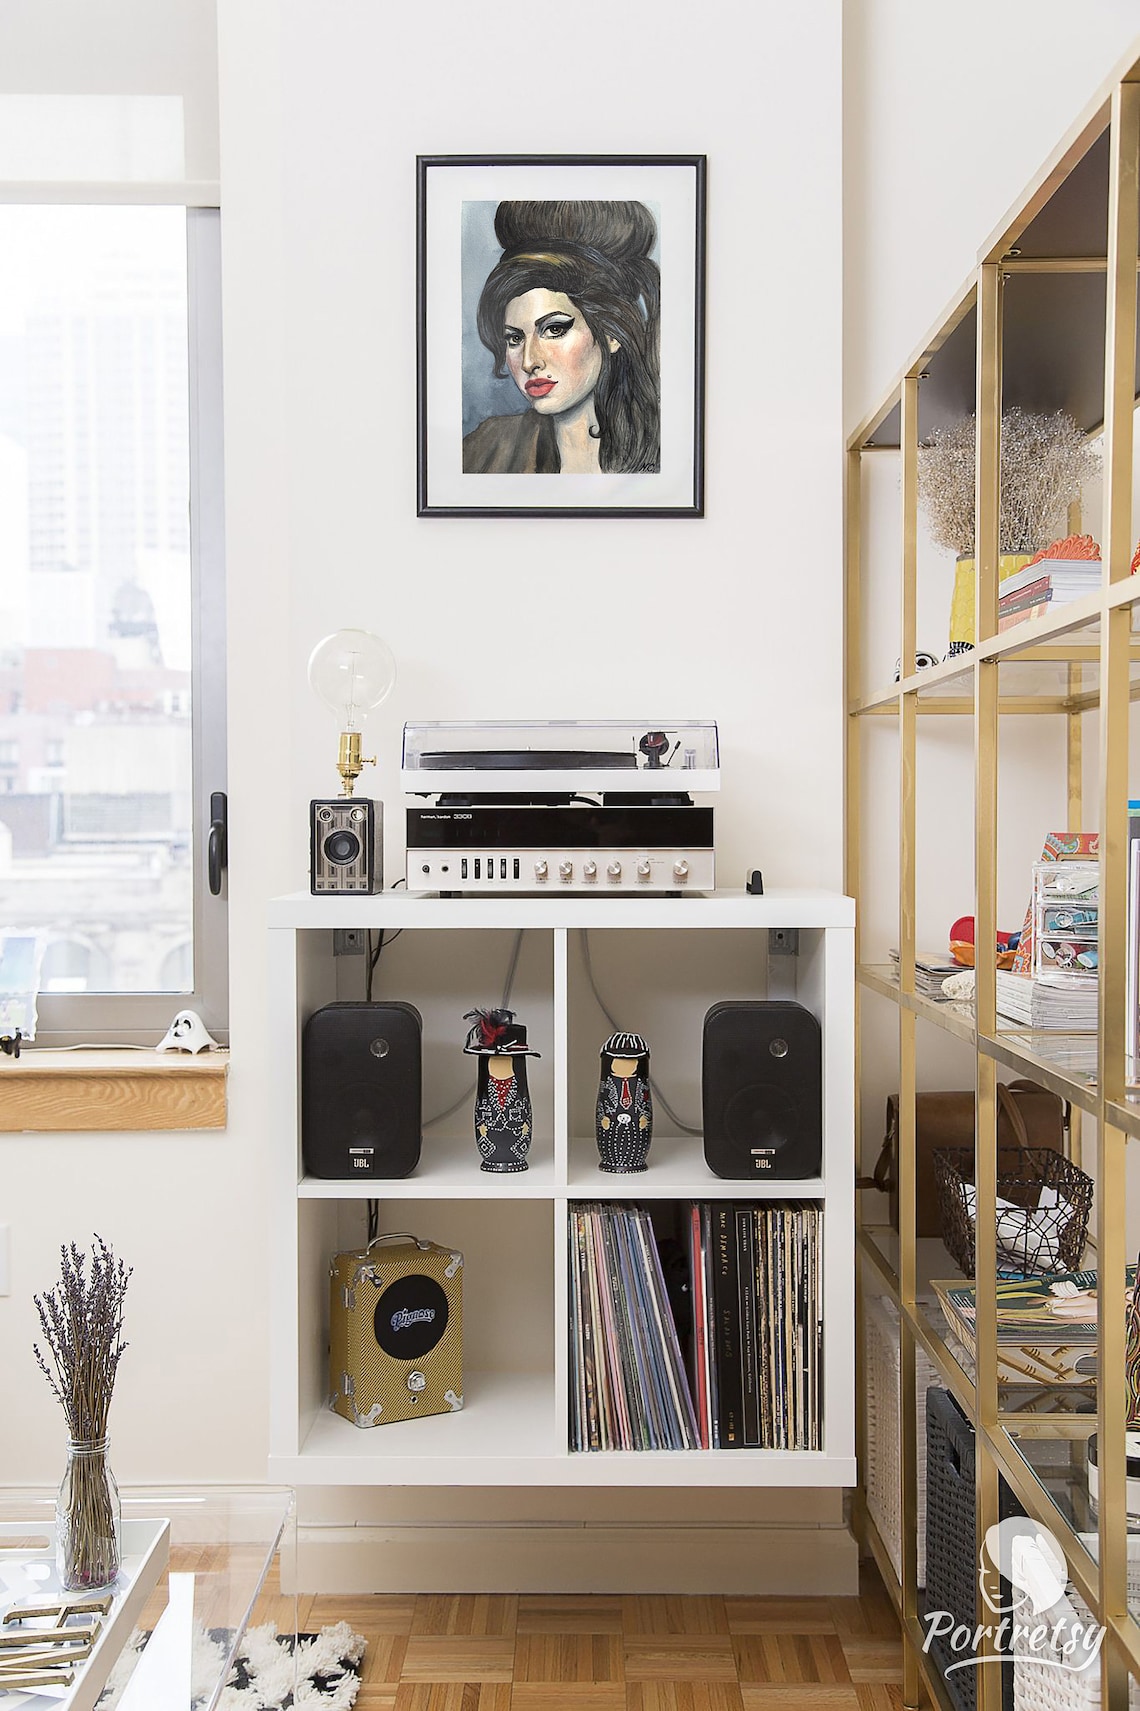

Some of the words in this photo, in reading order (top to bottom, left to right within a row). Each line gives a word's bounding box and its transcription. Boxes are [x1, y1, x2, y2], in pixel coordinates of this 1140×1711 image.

[353, 1158, 370, 1168] JBL
[755, 1159, 772, 1169] JBL
[719, 1212, 727, 1229] MAC
[390, 1307, 436, 1332] Pignose
